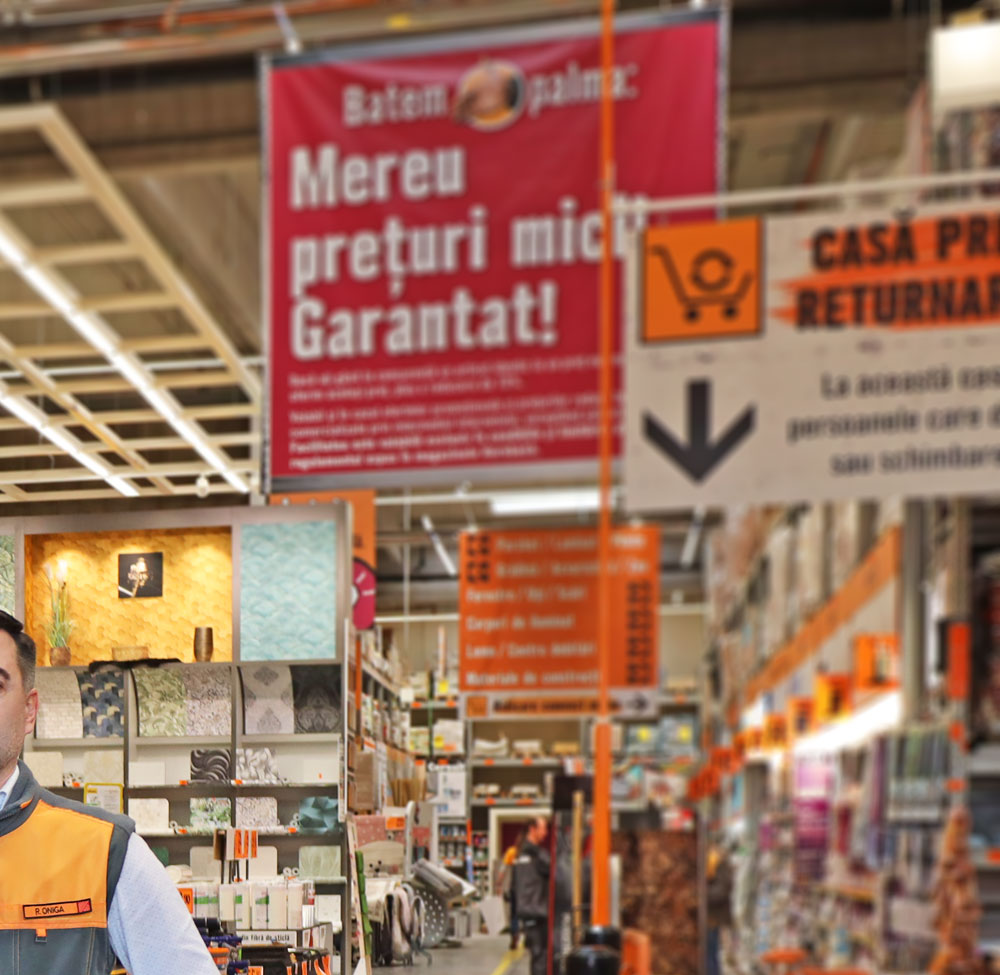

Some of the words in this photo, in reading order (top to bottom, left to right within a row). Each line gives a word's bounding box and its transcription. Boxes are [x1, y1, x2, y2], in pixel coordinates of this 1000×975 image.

[343, 82, 448, 127] Batem
[289, 143, 466, 211] Mereu
[289, 204, 489, 300] prețuri
[811, 206, 917, 272] CASĂ
[289, 281, 559, 361] Garantat!
[42, 905, 65, 915] ONIGA
